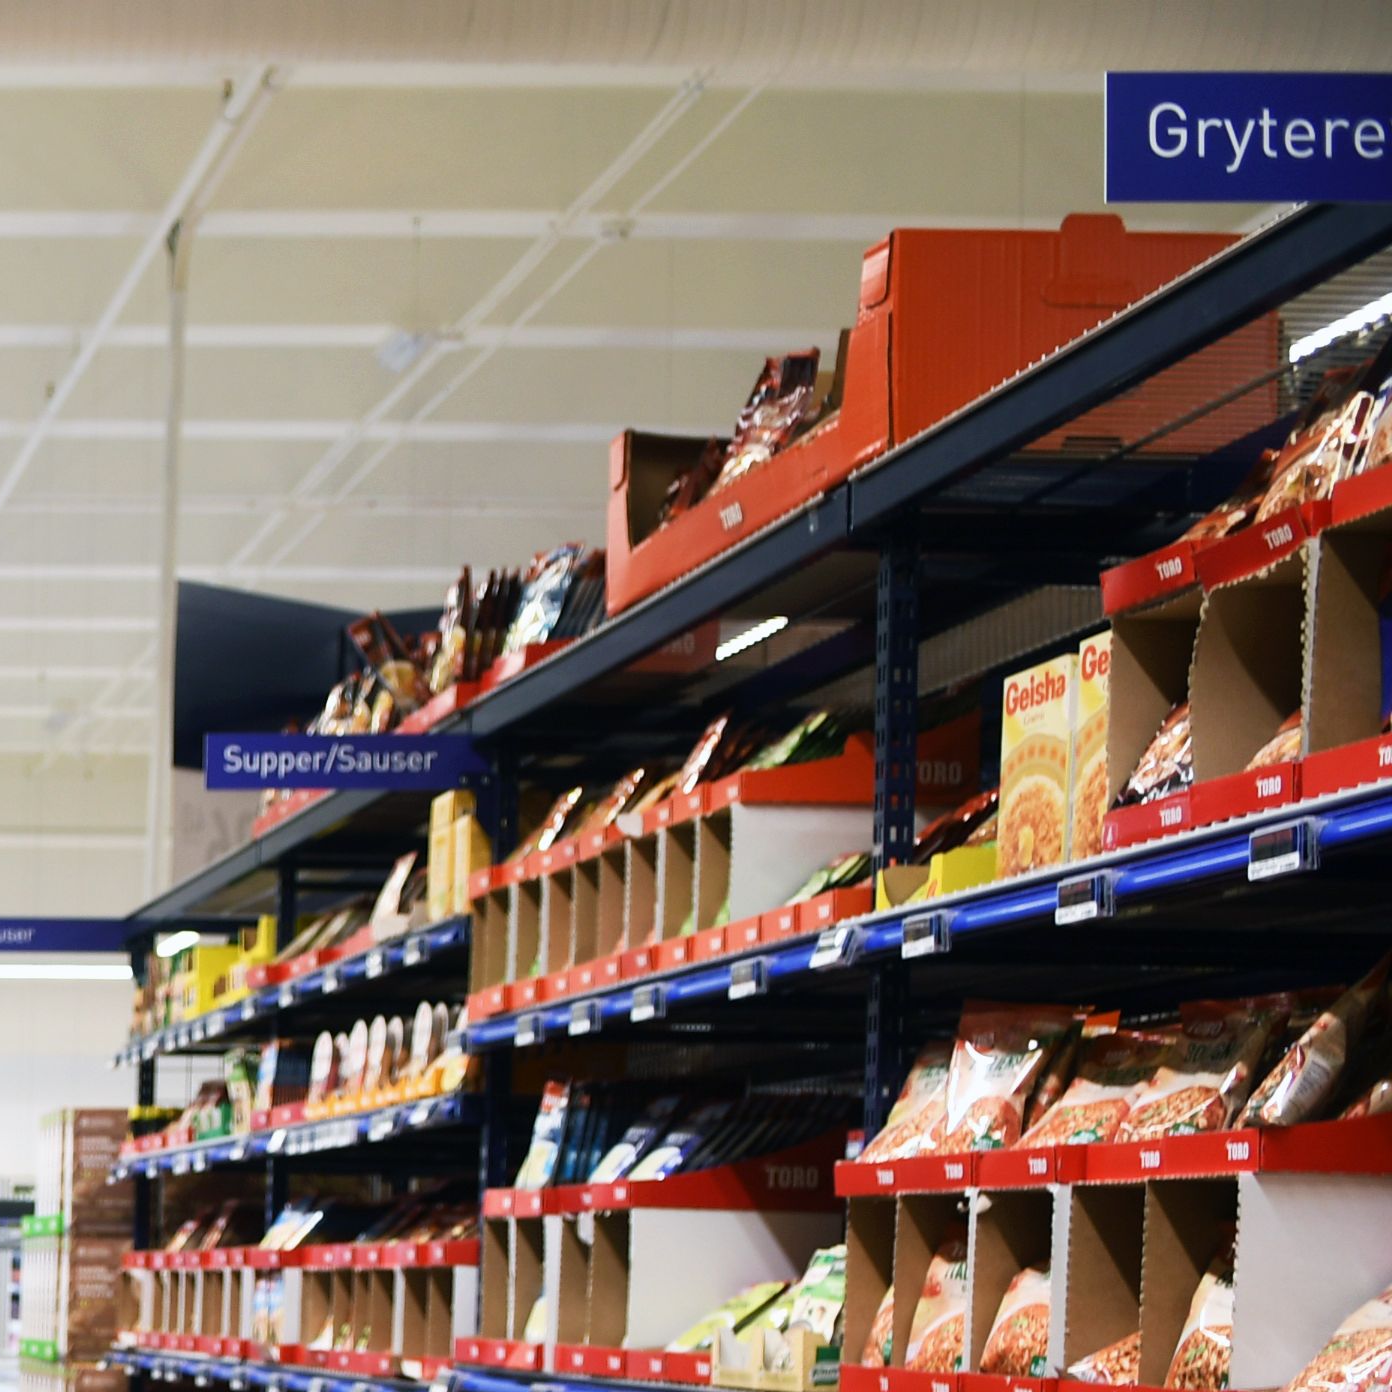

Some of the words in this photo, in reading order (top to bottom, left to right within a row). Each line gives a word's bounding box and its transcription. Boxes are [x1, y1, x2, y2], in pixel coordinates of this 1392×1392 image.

[1148, 102, 1392, 173] Grytere
[1264, 523, 1294, 550] TORO
[1156, 557, 1183, 582] TORO
[1006, 671, 1066, 716] Geisha
[222, 743, 438, 778] Supper/Sauser
[916, 760, 962, 785] ORO
[1256, 775, 1282, 799] TORO
[1159, 805, 1183, 827] TORO
[1140, 1150, 1161, 1168] TORO
[1226, 1142, 1250, 1161] TORO
